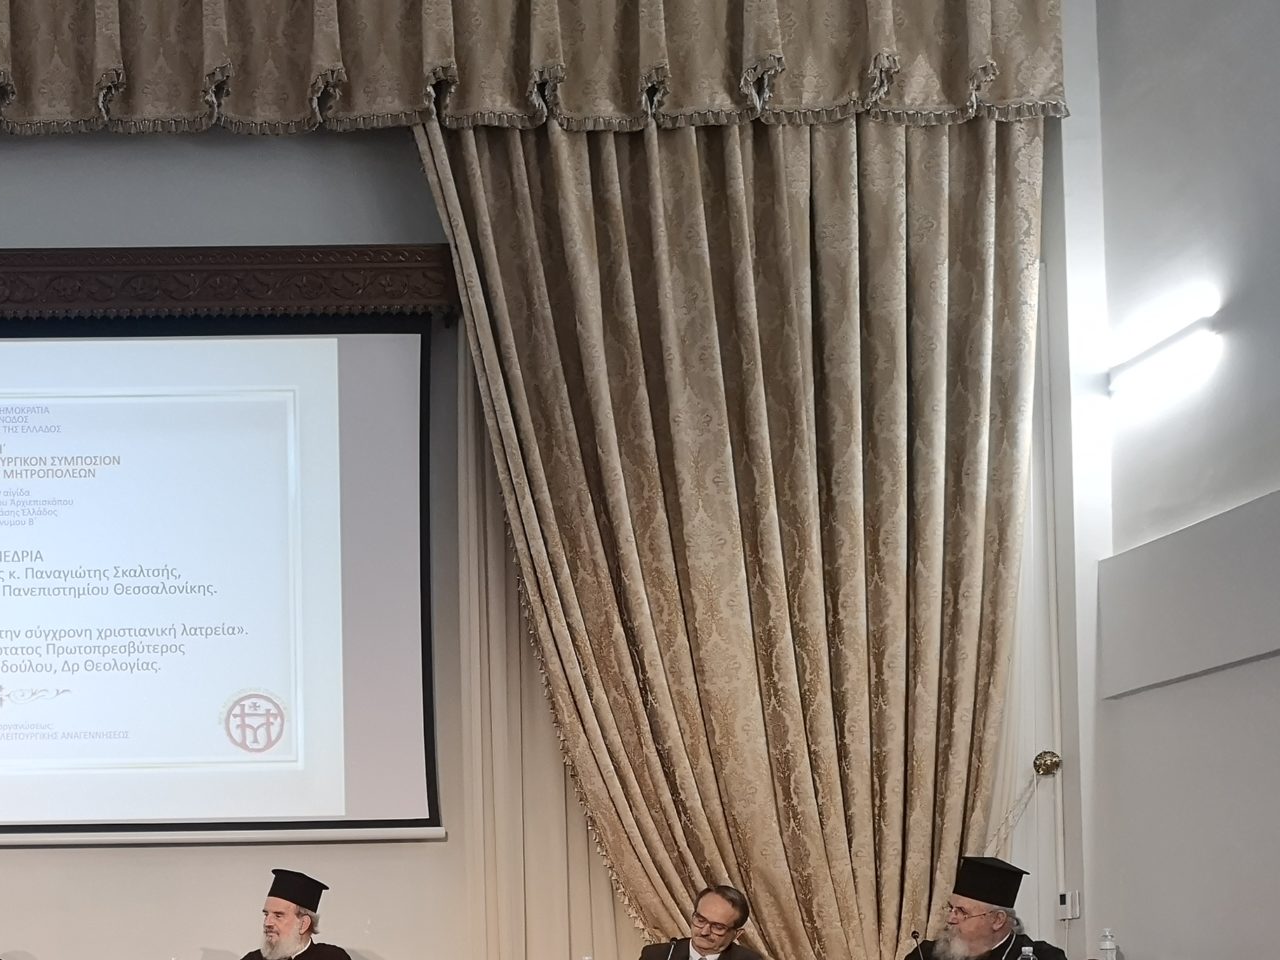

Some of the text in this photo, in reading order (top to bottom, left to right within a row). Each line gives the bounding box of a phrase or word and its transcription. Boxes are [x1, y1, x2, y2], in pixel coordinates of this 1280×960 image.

[3, 425, 19, 434] ΤΗΣ
[21, 424, 62, 433] ΕΛΛΑΔΟΣ
[50, 455, 121, 467] ΣΥΜΠΟΣΙΟΝ
[3, 467, 96, 480] ΜΗΤΡΟΠΟΛΕΩΝ
[8, 569, 20, 579] κ.
[24, 566, 110, 582] Παναγιώτης
[113, 565, 182, 581] Σκαλτσής,
[2, 583, 109, 599] Πανεπιστημίου
[113, 581, 218, 597] Θεσσαλονίκης.
[25, 625, 93, 642] σύγχρονη
[96, 624, 178, 641] χριστιανική
[181, 623, 249, 639] λατρεία».
[46, 641, 186, 658] Πρωτοπρεσβύτερος
[61, 660, 80, 675] Δρ
[84, 659, 161, 675] Θεολογίας.
